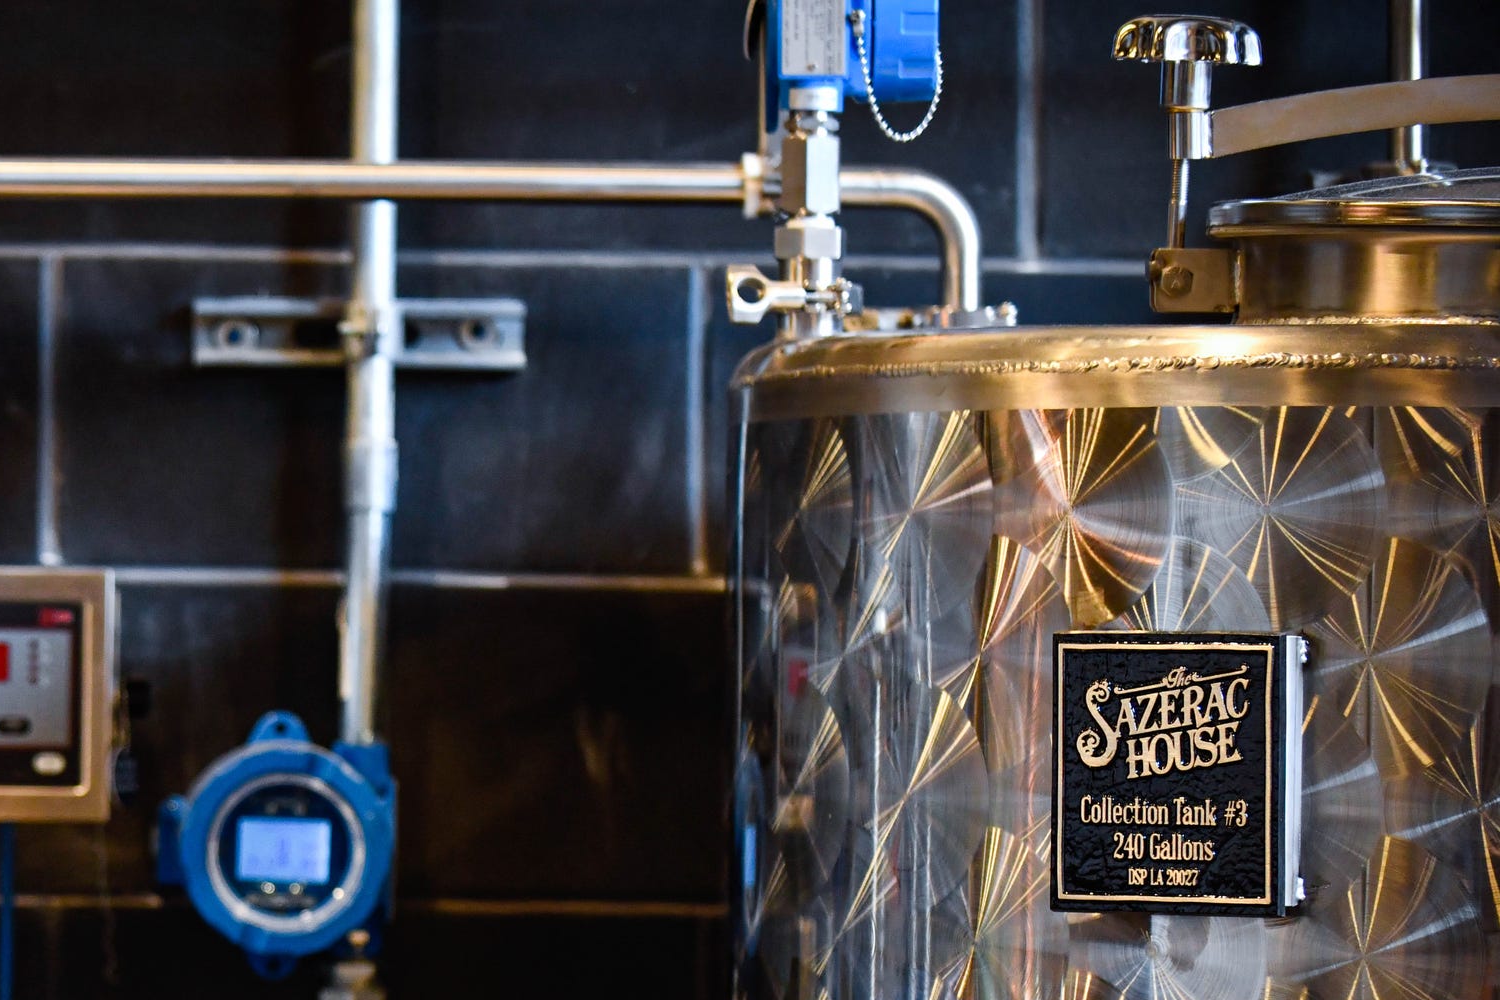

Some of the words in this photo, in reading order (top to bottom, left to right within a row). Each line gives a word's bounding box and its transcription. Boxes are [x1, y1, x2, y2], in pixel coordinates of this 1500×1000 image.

[1166, 667, 1192, 688] The
[1076, 677, 1251, 768] SAZERAC
[1126, 721, 1244, 779] HOUSE
[1080, 794, 1169, 825] Collection
[1173, 797, 1217, 827] Tank
[1223, 799, 1248, 827] #3
[1113, 832, 1145, 860] 240
[1149, 833, 1214, 862] Gallons
[1128, 868, 1147, 886] DSP
[1150, 868, 1164, 886] LA
[1166, 868, 1199, 887] 20027
